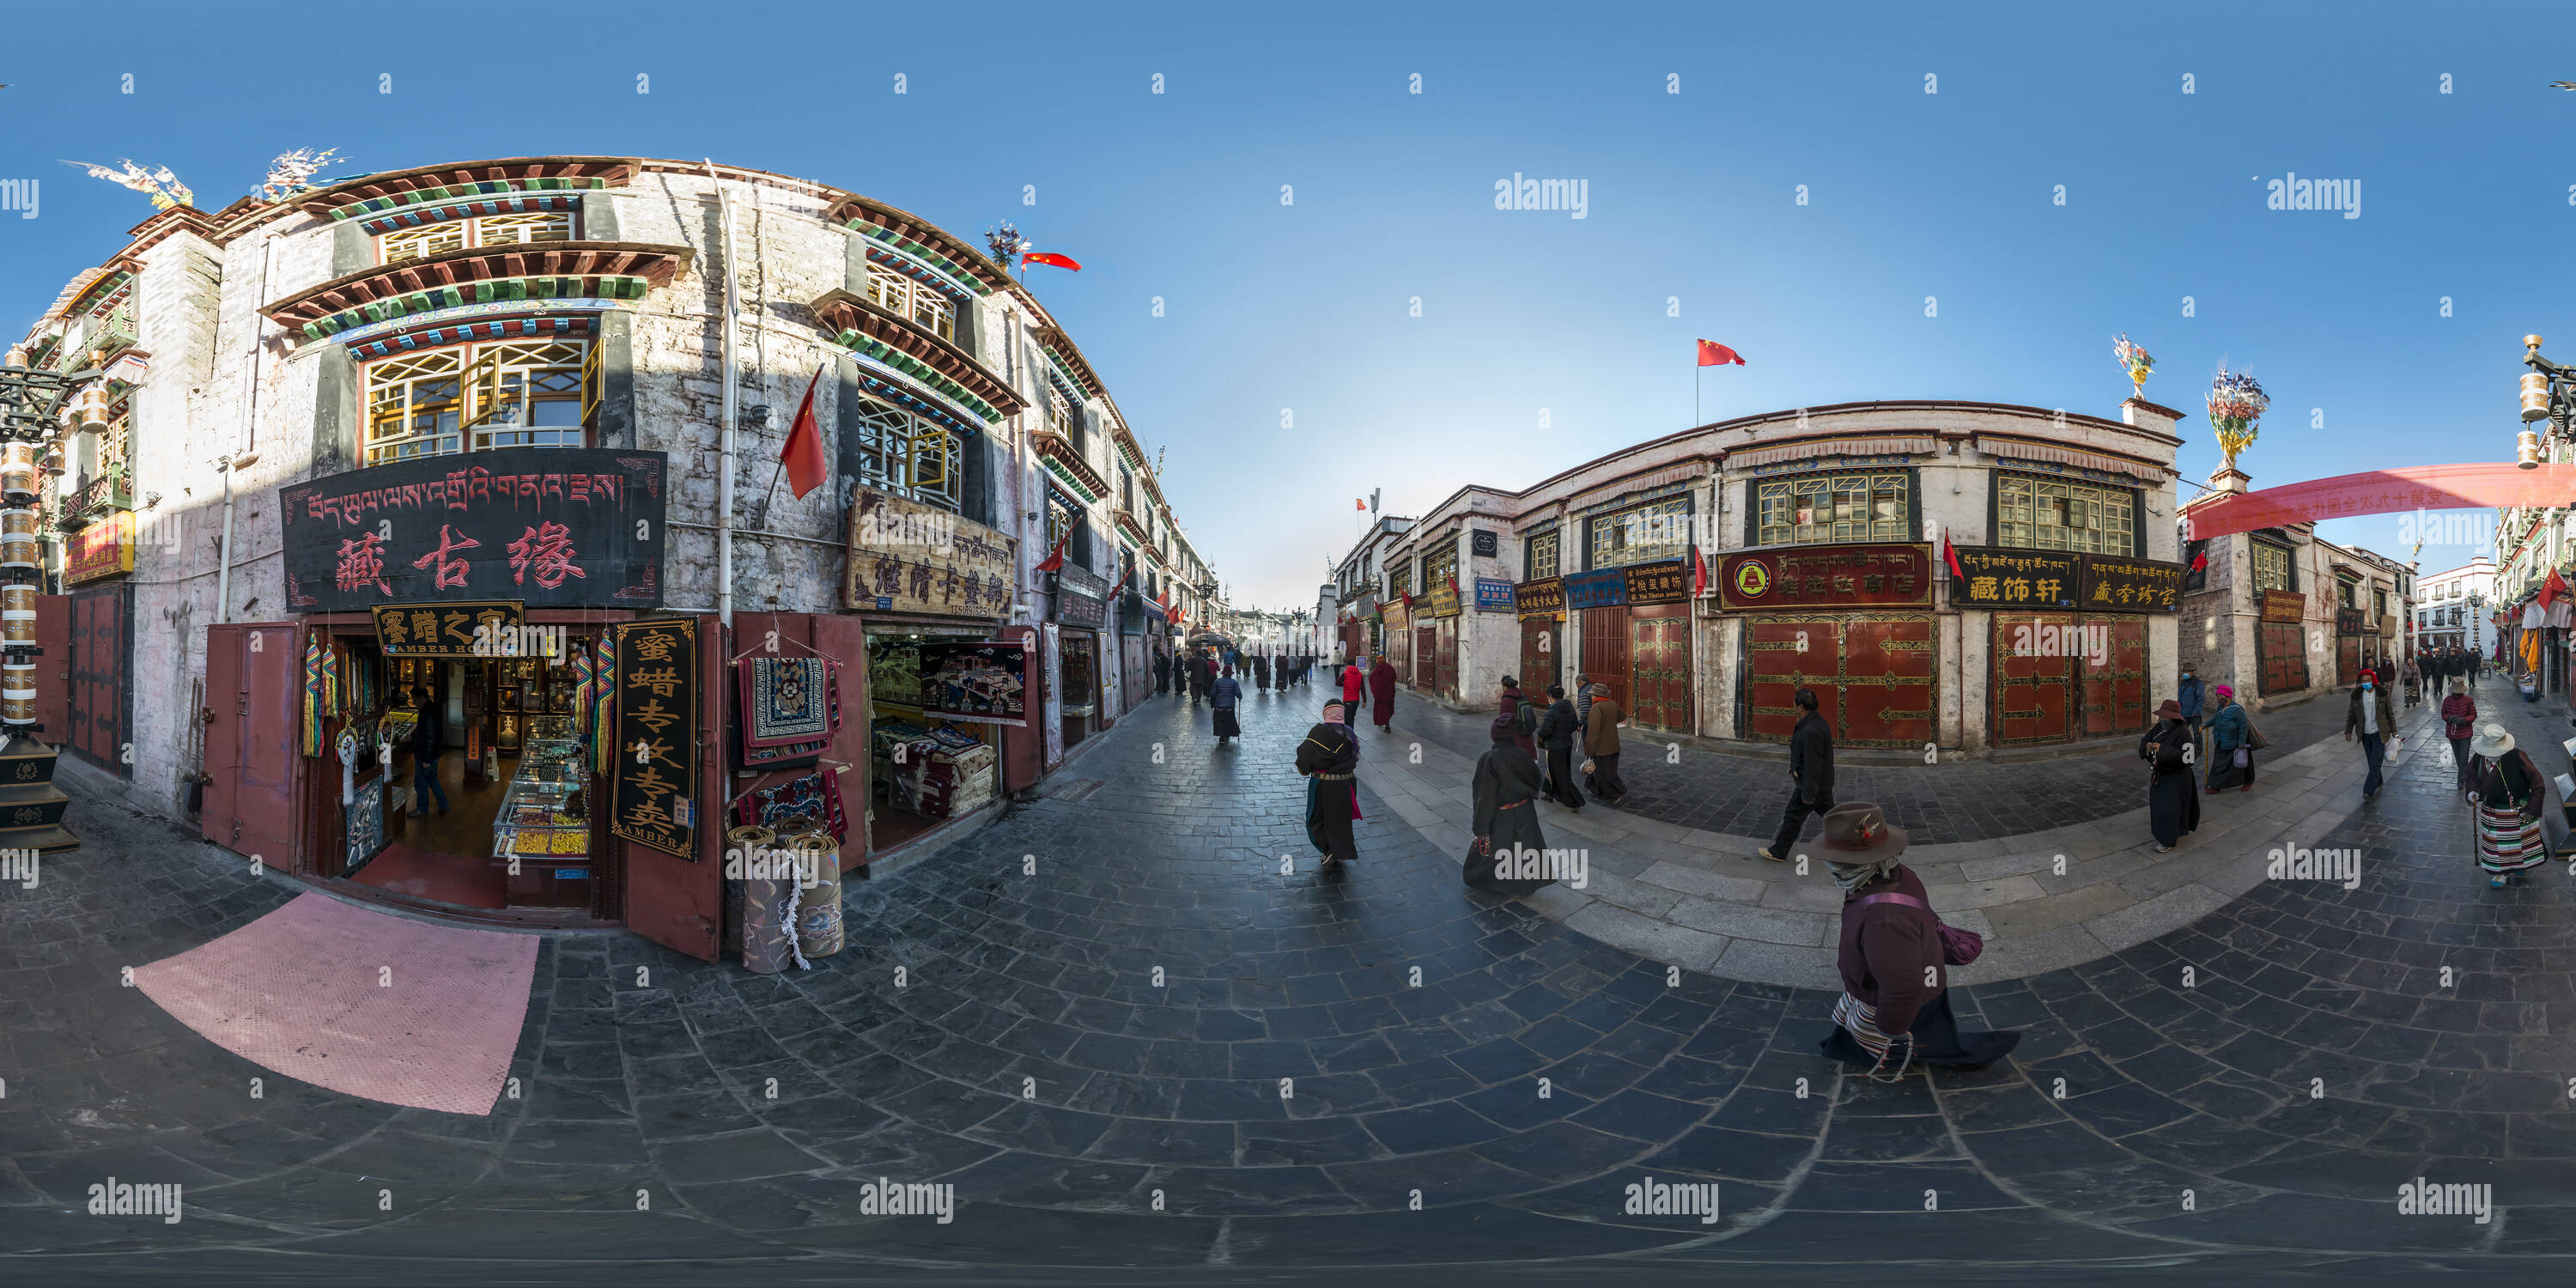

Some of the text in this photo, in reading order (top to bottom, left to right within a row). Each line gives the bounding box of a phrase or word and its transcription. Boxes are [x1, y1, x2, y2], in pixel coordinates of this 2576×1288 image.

[337, 520, 586, 597] 藏古缘
[1970, 575, 2063, 603] 藏饰轩
[2092, 580, 2176, 605] 藏圣珍宝
[380, 608, 507, 644] 蜜蜡之家
[396, 645, 448, 653] AMBER
[623, 629, 684, 835] 蜜蜡专收专卖
[623, 825, 677, 848] AMBER
